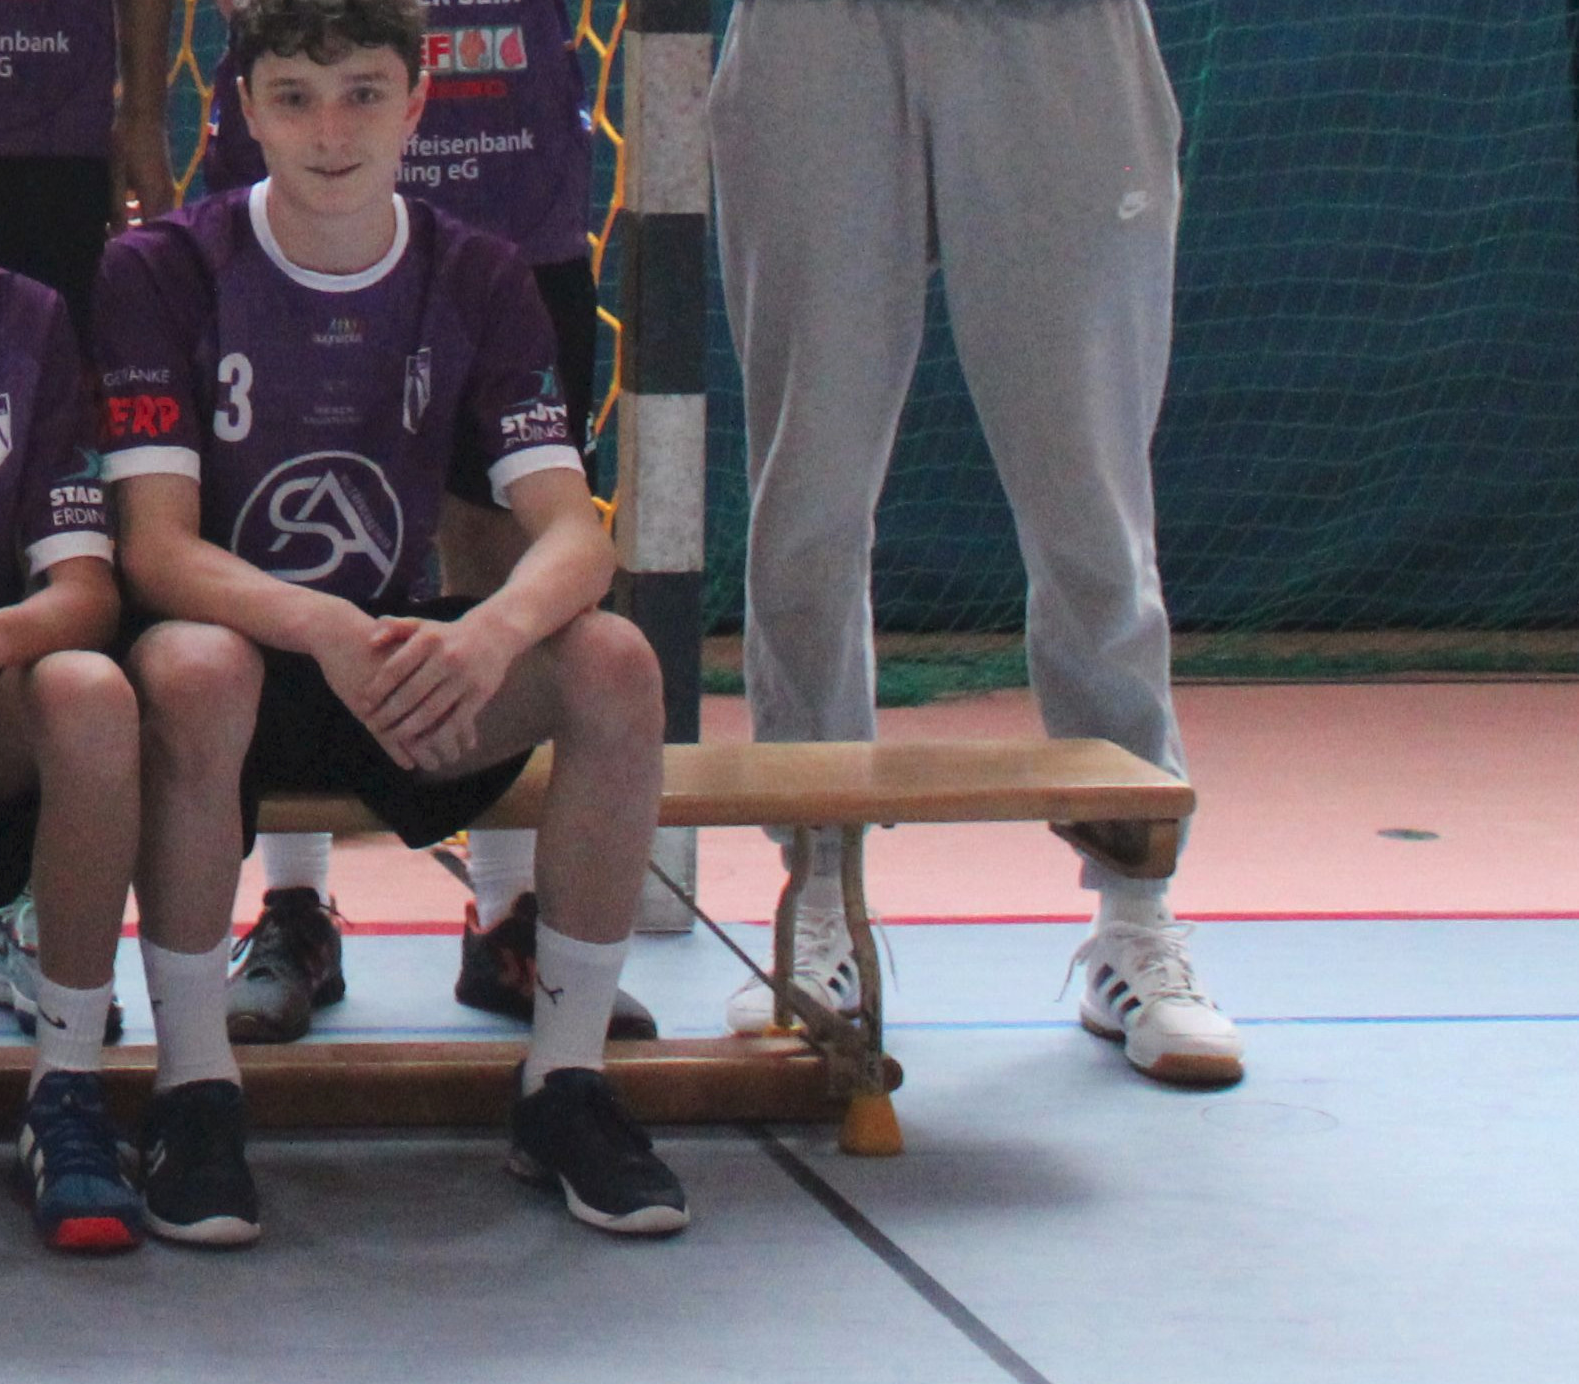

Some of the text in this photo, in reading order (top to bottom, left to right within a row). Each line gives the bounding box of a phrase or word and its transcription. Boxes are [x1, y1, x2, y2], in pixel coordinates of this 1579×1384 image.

[402, 128, 535, 157] ffeisenbank
[448, 159, 480, 180] eG
[213, 353, 254, 442] 3
[53, 508, 106, 526] ERDIN
